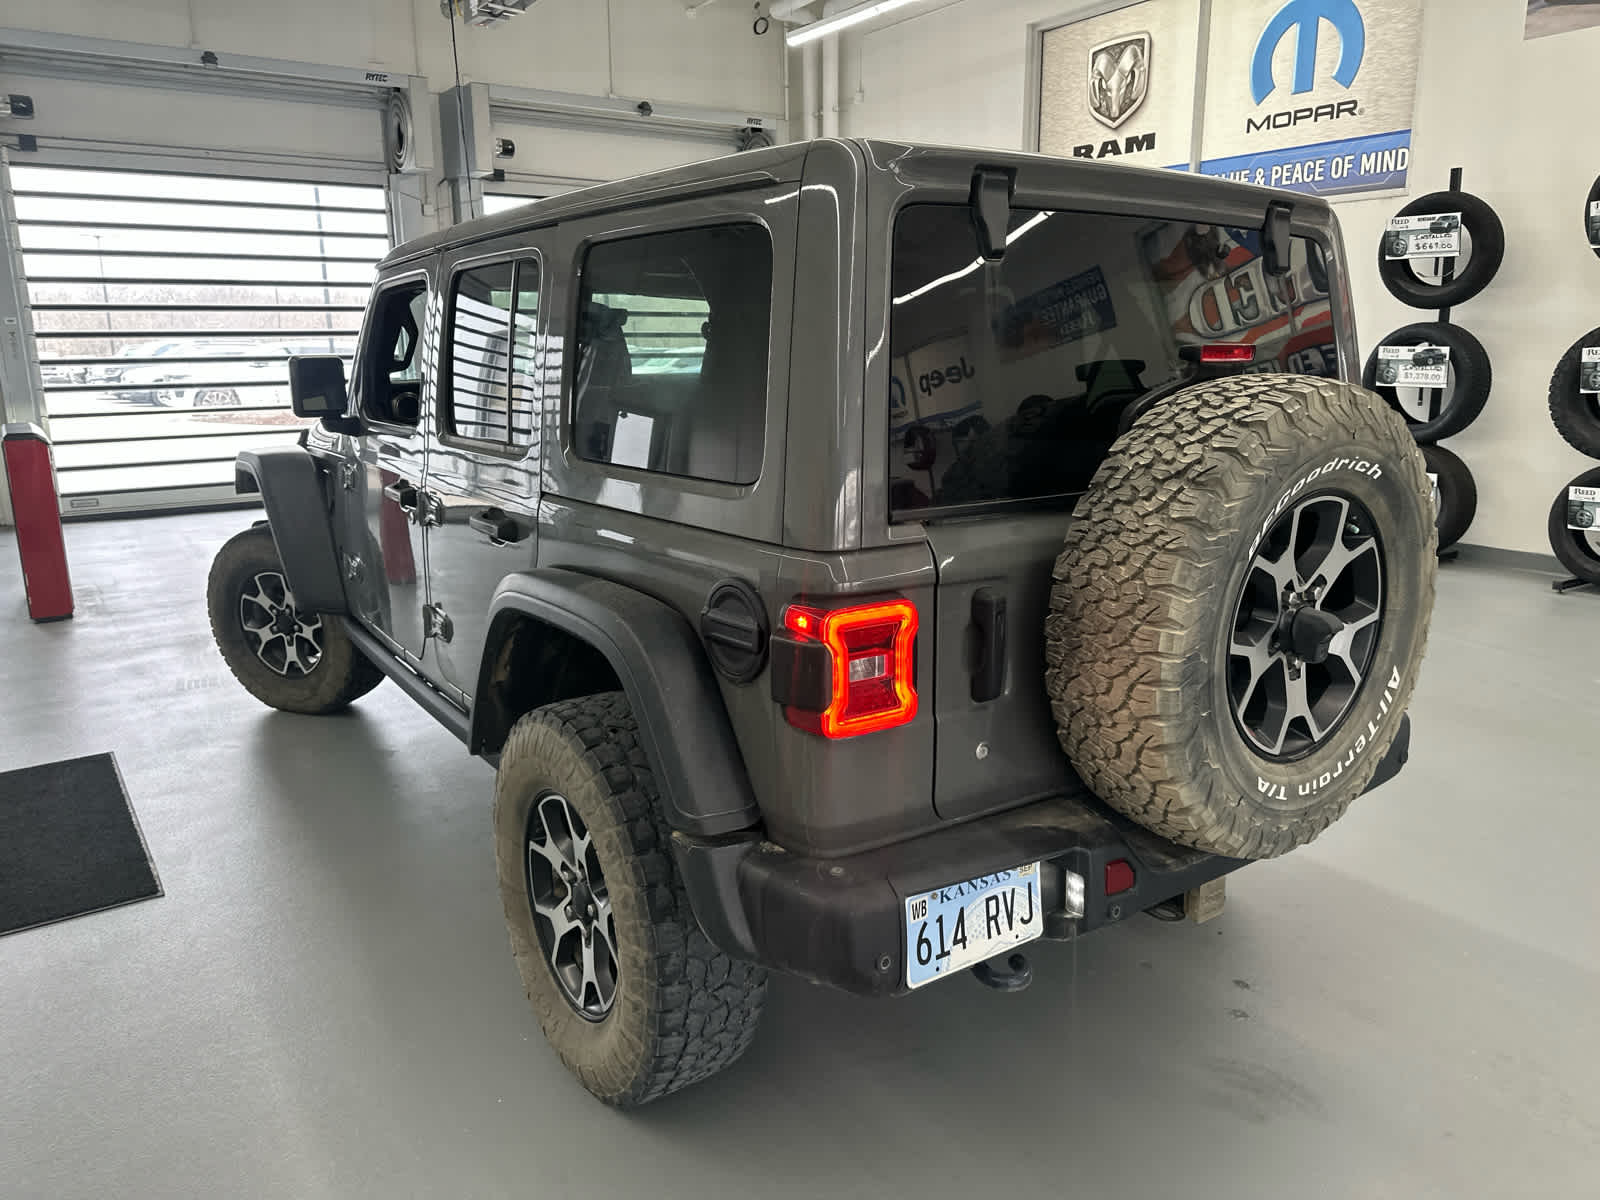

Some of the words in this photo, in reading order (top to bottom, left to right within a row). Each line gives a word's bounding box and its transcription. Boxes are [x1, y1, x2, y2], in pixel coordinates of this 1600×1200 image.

[1246, 99, 1358, 134] MOPAR
[1073, 132, 1156, 159] RAM
[1271, 159, 1326, 187] PEACE
[1331, 155, 1355, 179] OF
[1360, 147, 1409, 176] MIND
[1257, 776, 1288, 801] T/A
[939, 870, 1012, 904] KANSAS
[911, 900, 927, 921] WB
[916, 906, 968, 966] 614
[985, 881, 1033, 940] RVJ
